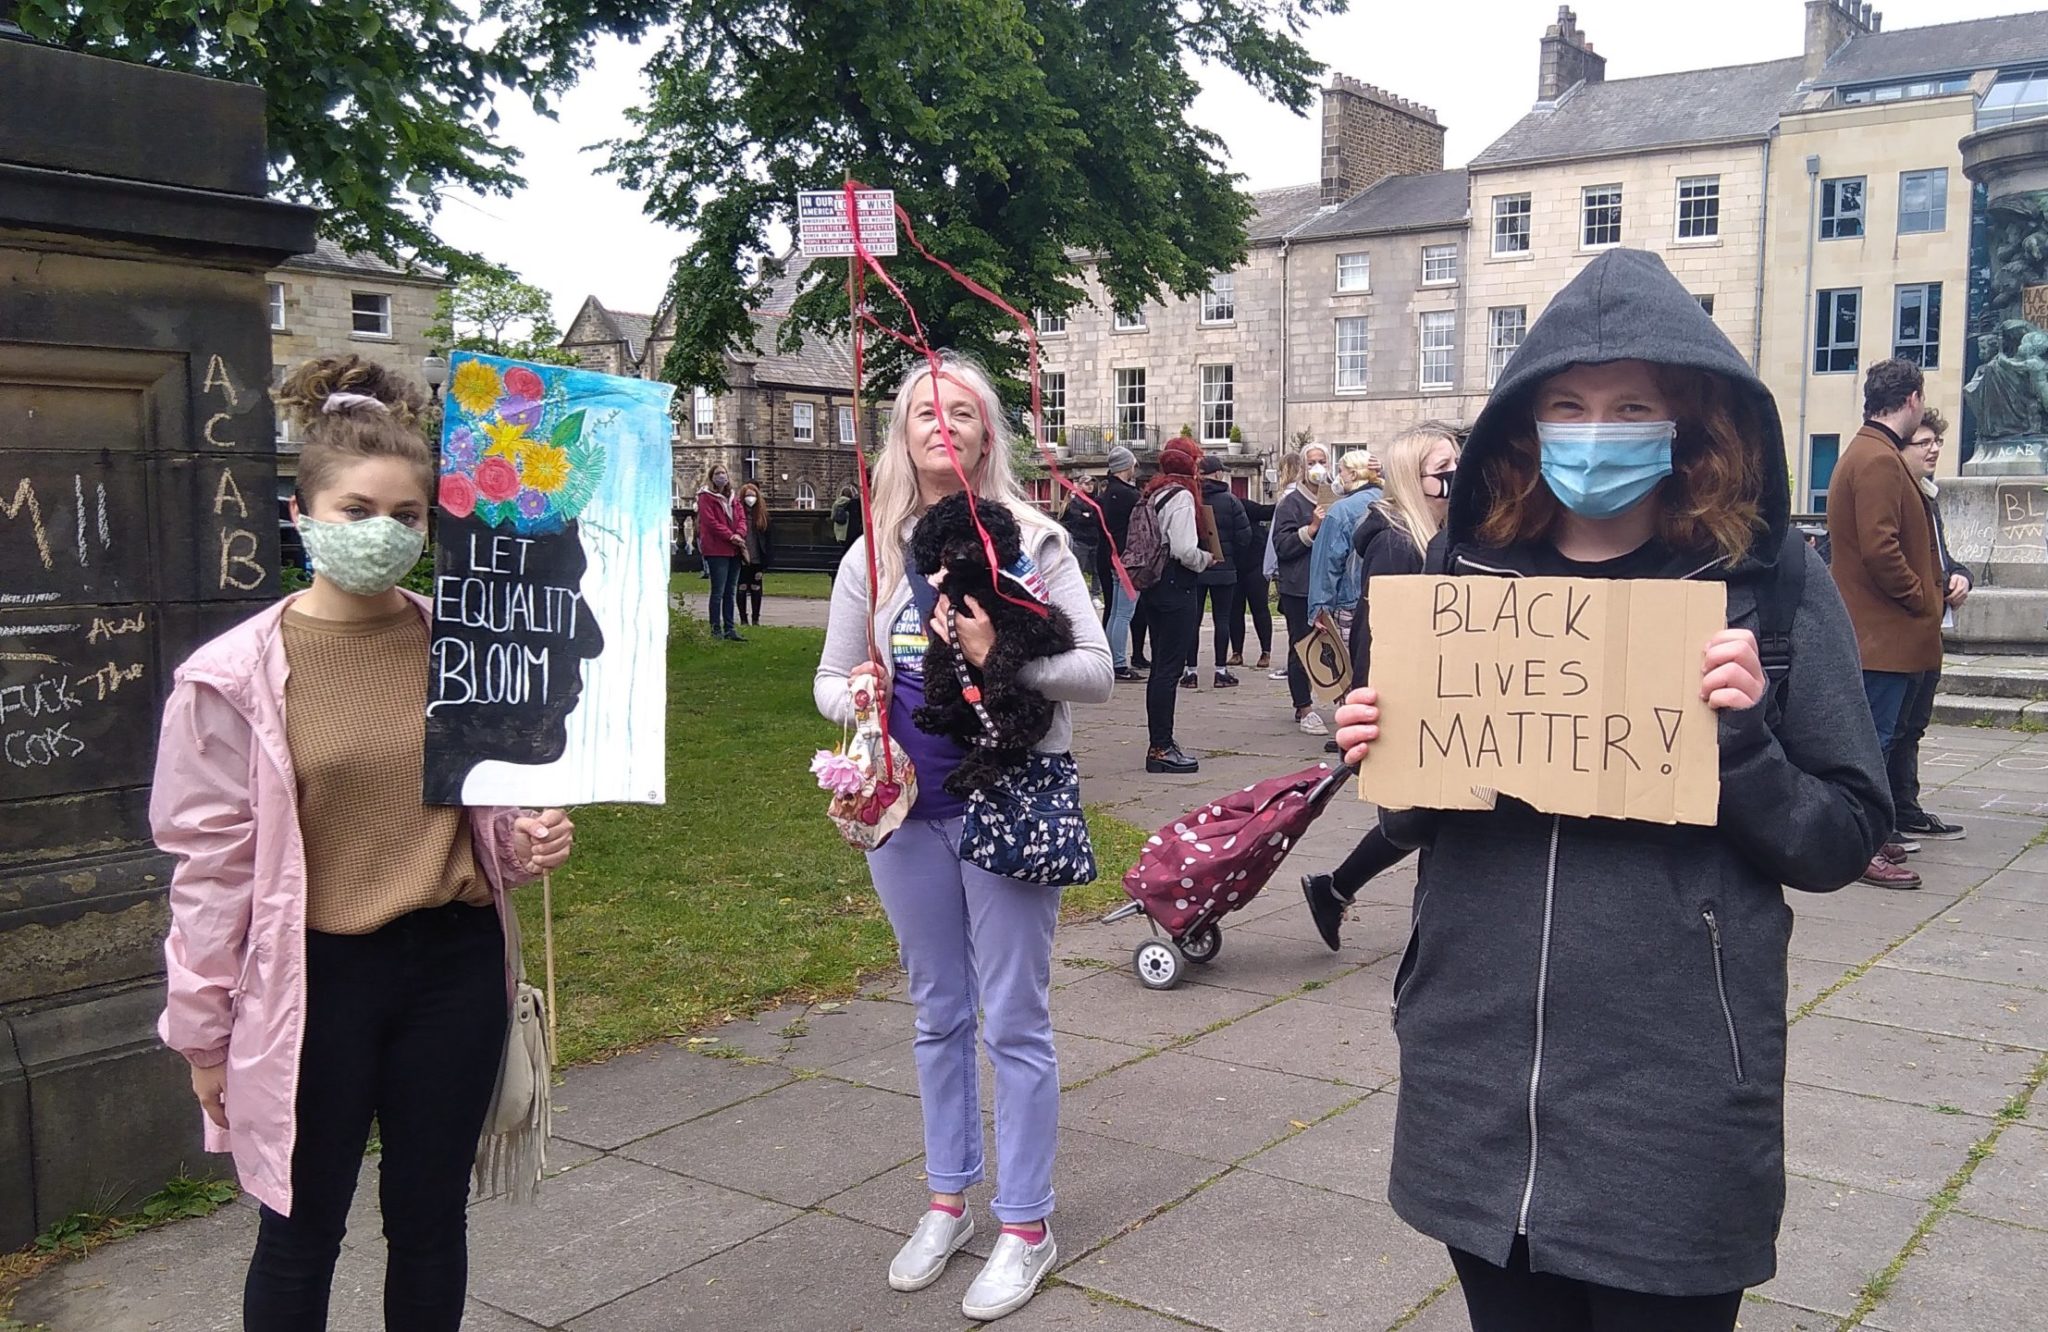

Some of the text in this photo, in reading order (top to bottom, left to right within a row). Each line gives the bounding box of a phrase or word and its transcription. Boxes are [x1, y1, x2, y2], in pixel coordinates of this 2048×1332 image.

[801, 196, 834, 207] IN OUR
[802, 208, 835, 216] AMERICA
[836, 200, 892, 209] LOE WINS
[853, 243, 895, 251] CEBRATED
[1997, 443, 2035, 457] ACAB
[470, 533, 536, 576] LET
[436, 575, 584, 639] EQUALITY
[1433, 581, 1592, 642] BLACK
[426, 637, 549, 718] BLOOM
[1437, 655, 1589, 699] LIVES
[0, 674, 82, 724] FUCK
